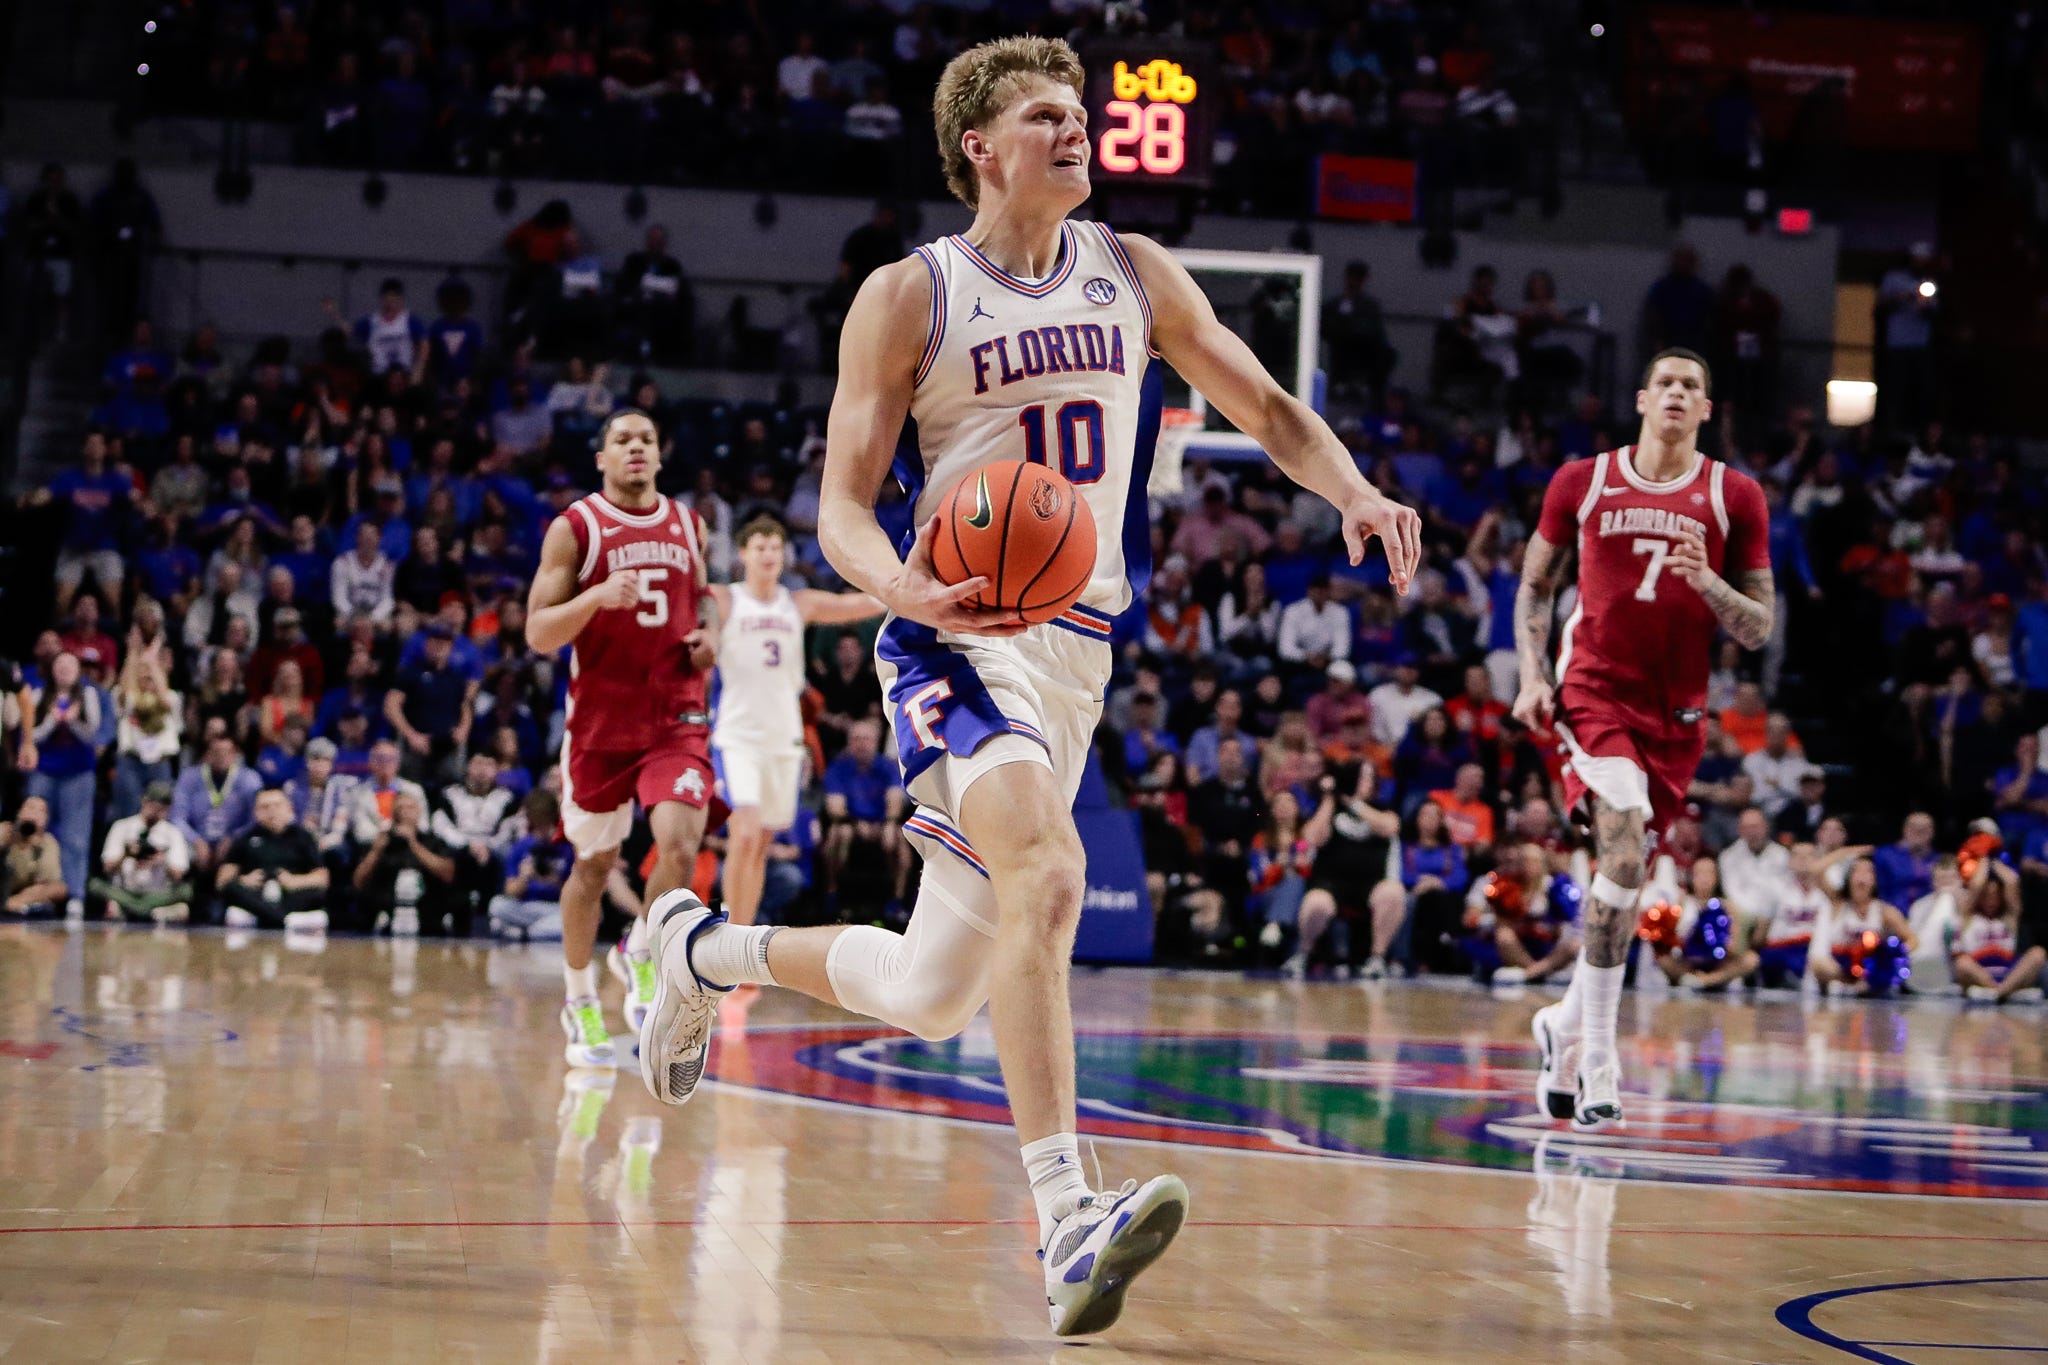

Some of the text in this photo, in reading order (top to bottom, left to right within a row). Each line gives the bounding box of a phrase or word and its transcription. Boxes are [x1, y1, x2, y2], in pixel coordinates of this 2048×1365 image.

[1113, 60, 1197, 104] 6:06
[1099, 101, 1186, 174] 28
[1084, 278, 1116, 305] SEC
[969, 323, 1126, 396] FLORIDA
[1019, 399, 1106, 485] 10
[606, 541, 690, 575] RAZORBACKS
[1631, 537, 1669, 602] 7
[636, 568, 669, 628] 5
[763, 640, 780, 667] 3
[903, 676, 954, 751] F
